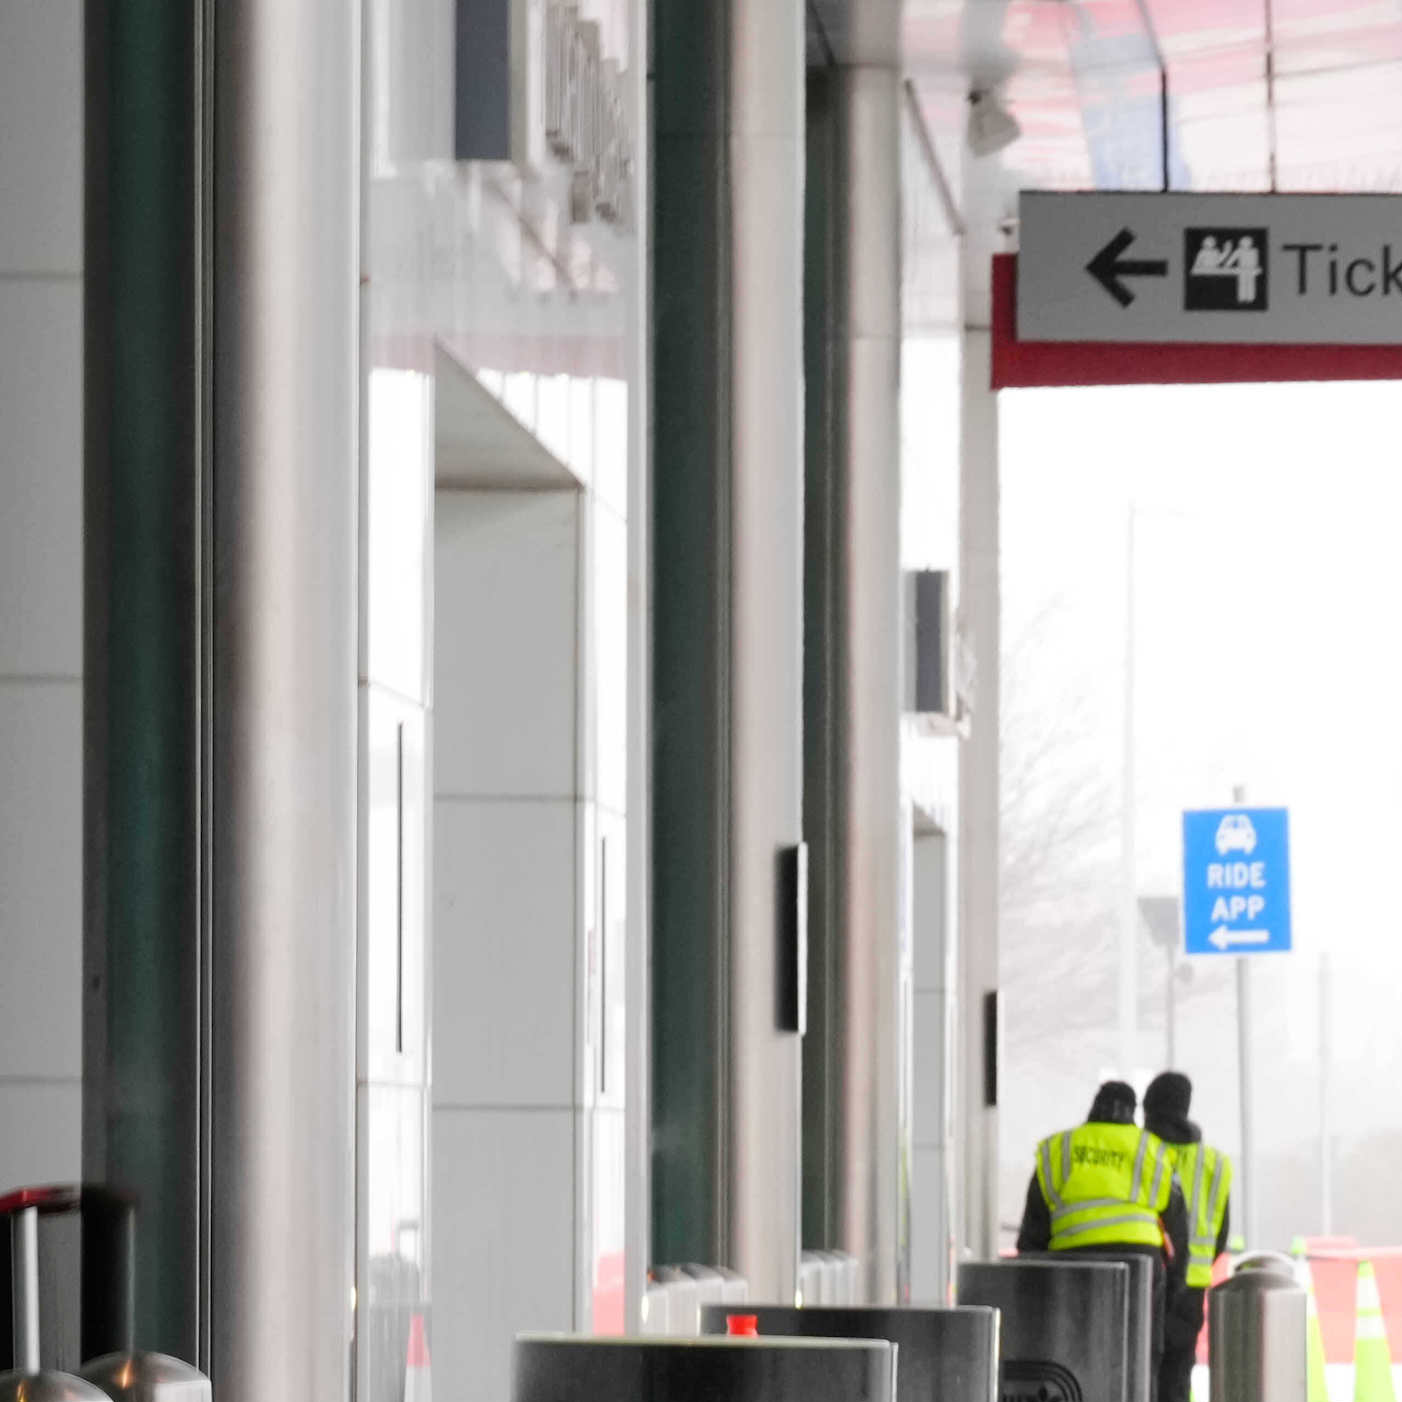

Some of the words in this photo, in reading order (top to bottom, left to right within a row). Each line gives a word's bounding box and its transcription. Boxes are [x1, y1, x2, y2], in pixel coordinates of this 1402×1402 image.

[1207, 862, 1265, 888] RIDE
[1211, 895, 1265, 922] APP
[1073, 1146, 1125, 1167] SECURITY
